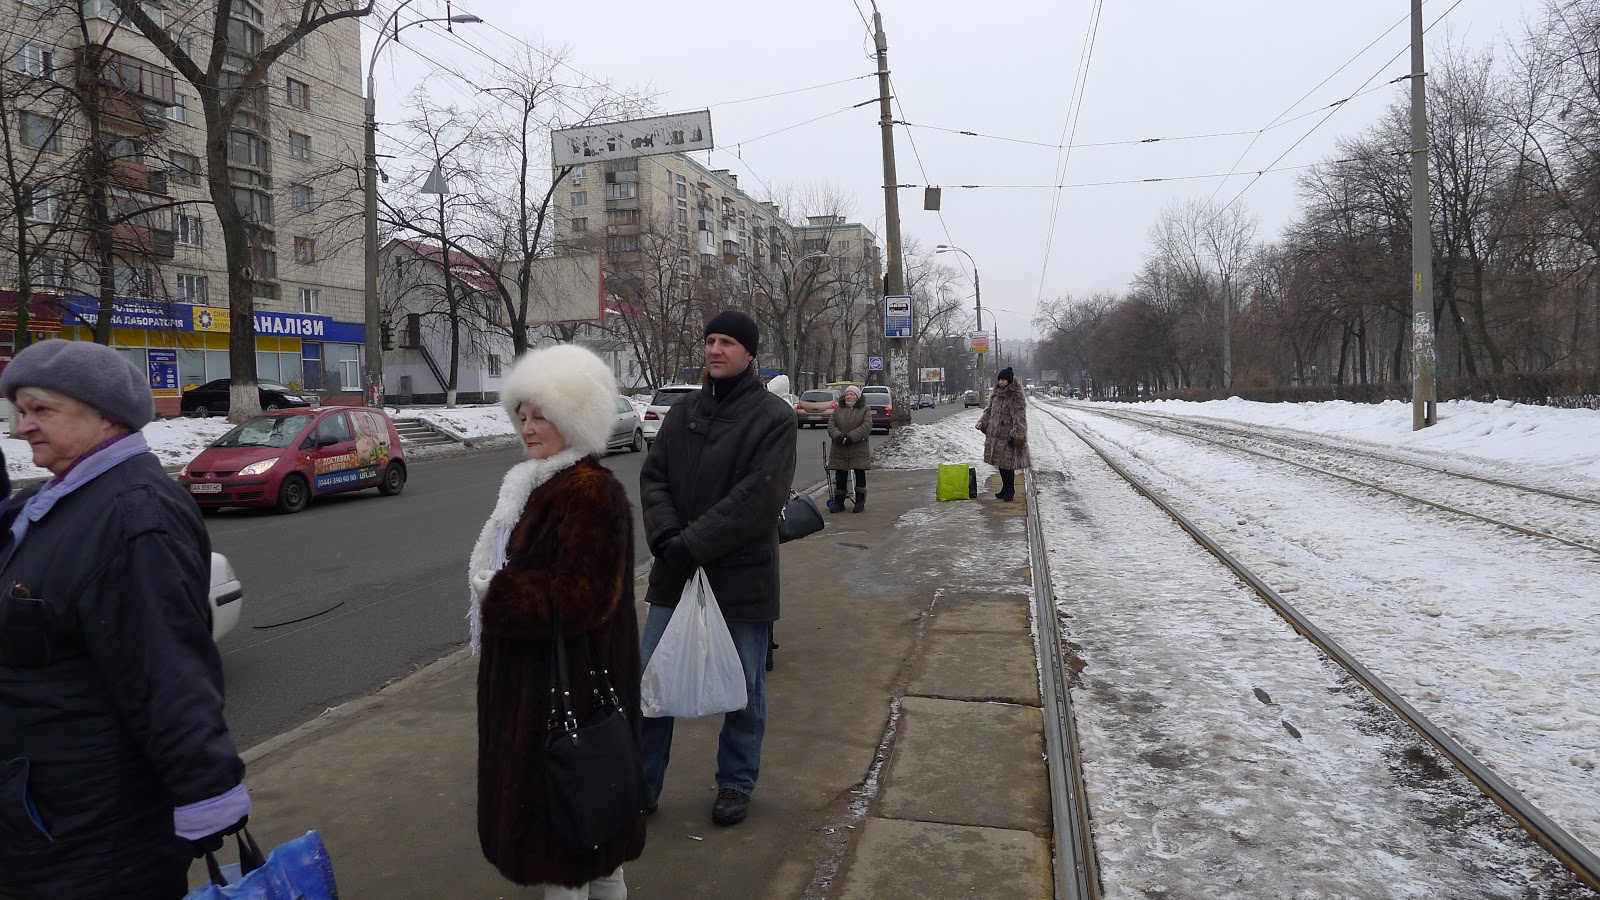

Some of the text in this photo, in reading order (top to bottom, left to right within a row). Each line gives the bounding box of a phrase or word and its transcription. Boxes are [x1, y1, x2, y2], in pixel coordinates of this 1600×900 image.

[253, 315, 324, 336] АНАЛІЗИ
[323, 455, 350, 465] ДОСТАВКА
[360, 471, 377, 479] UFL.UA
